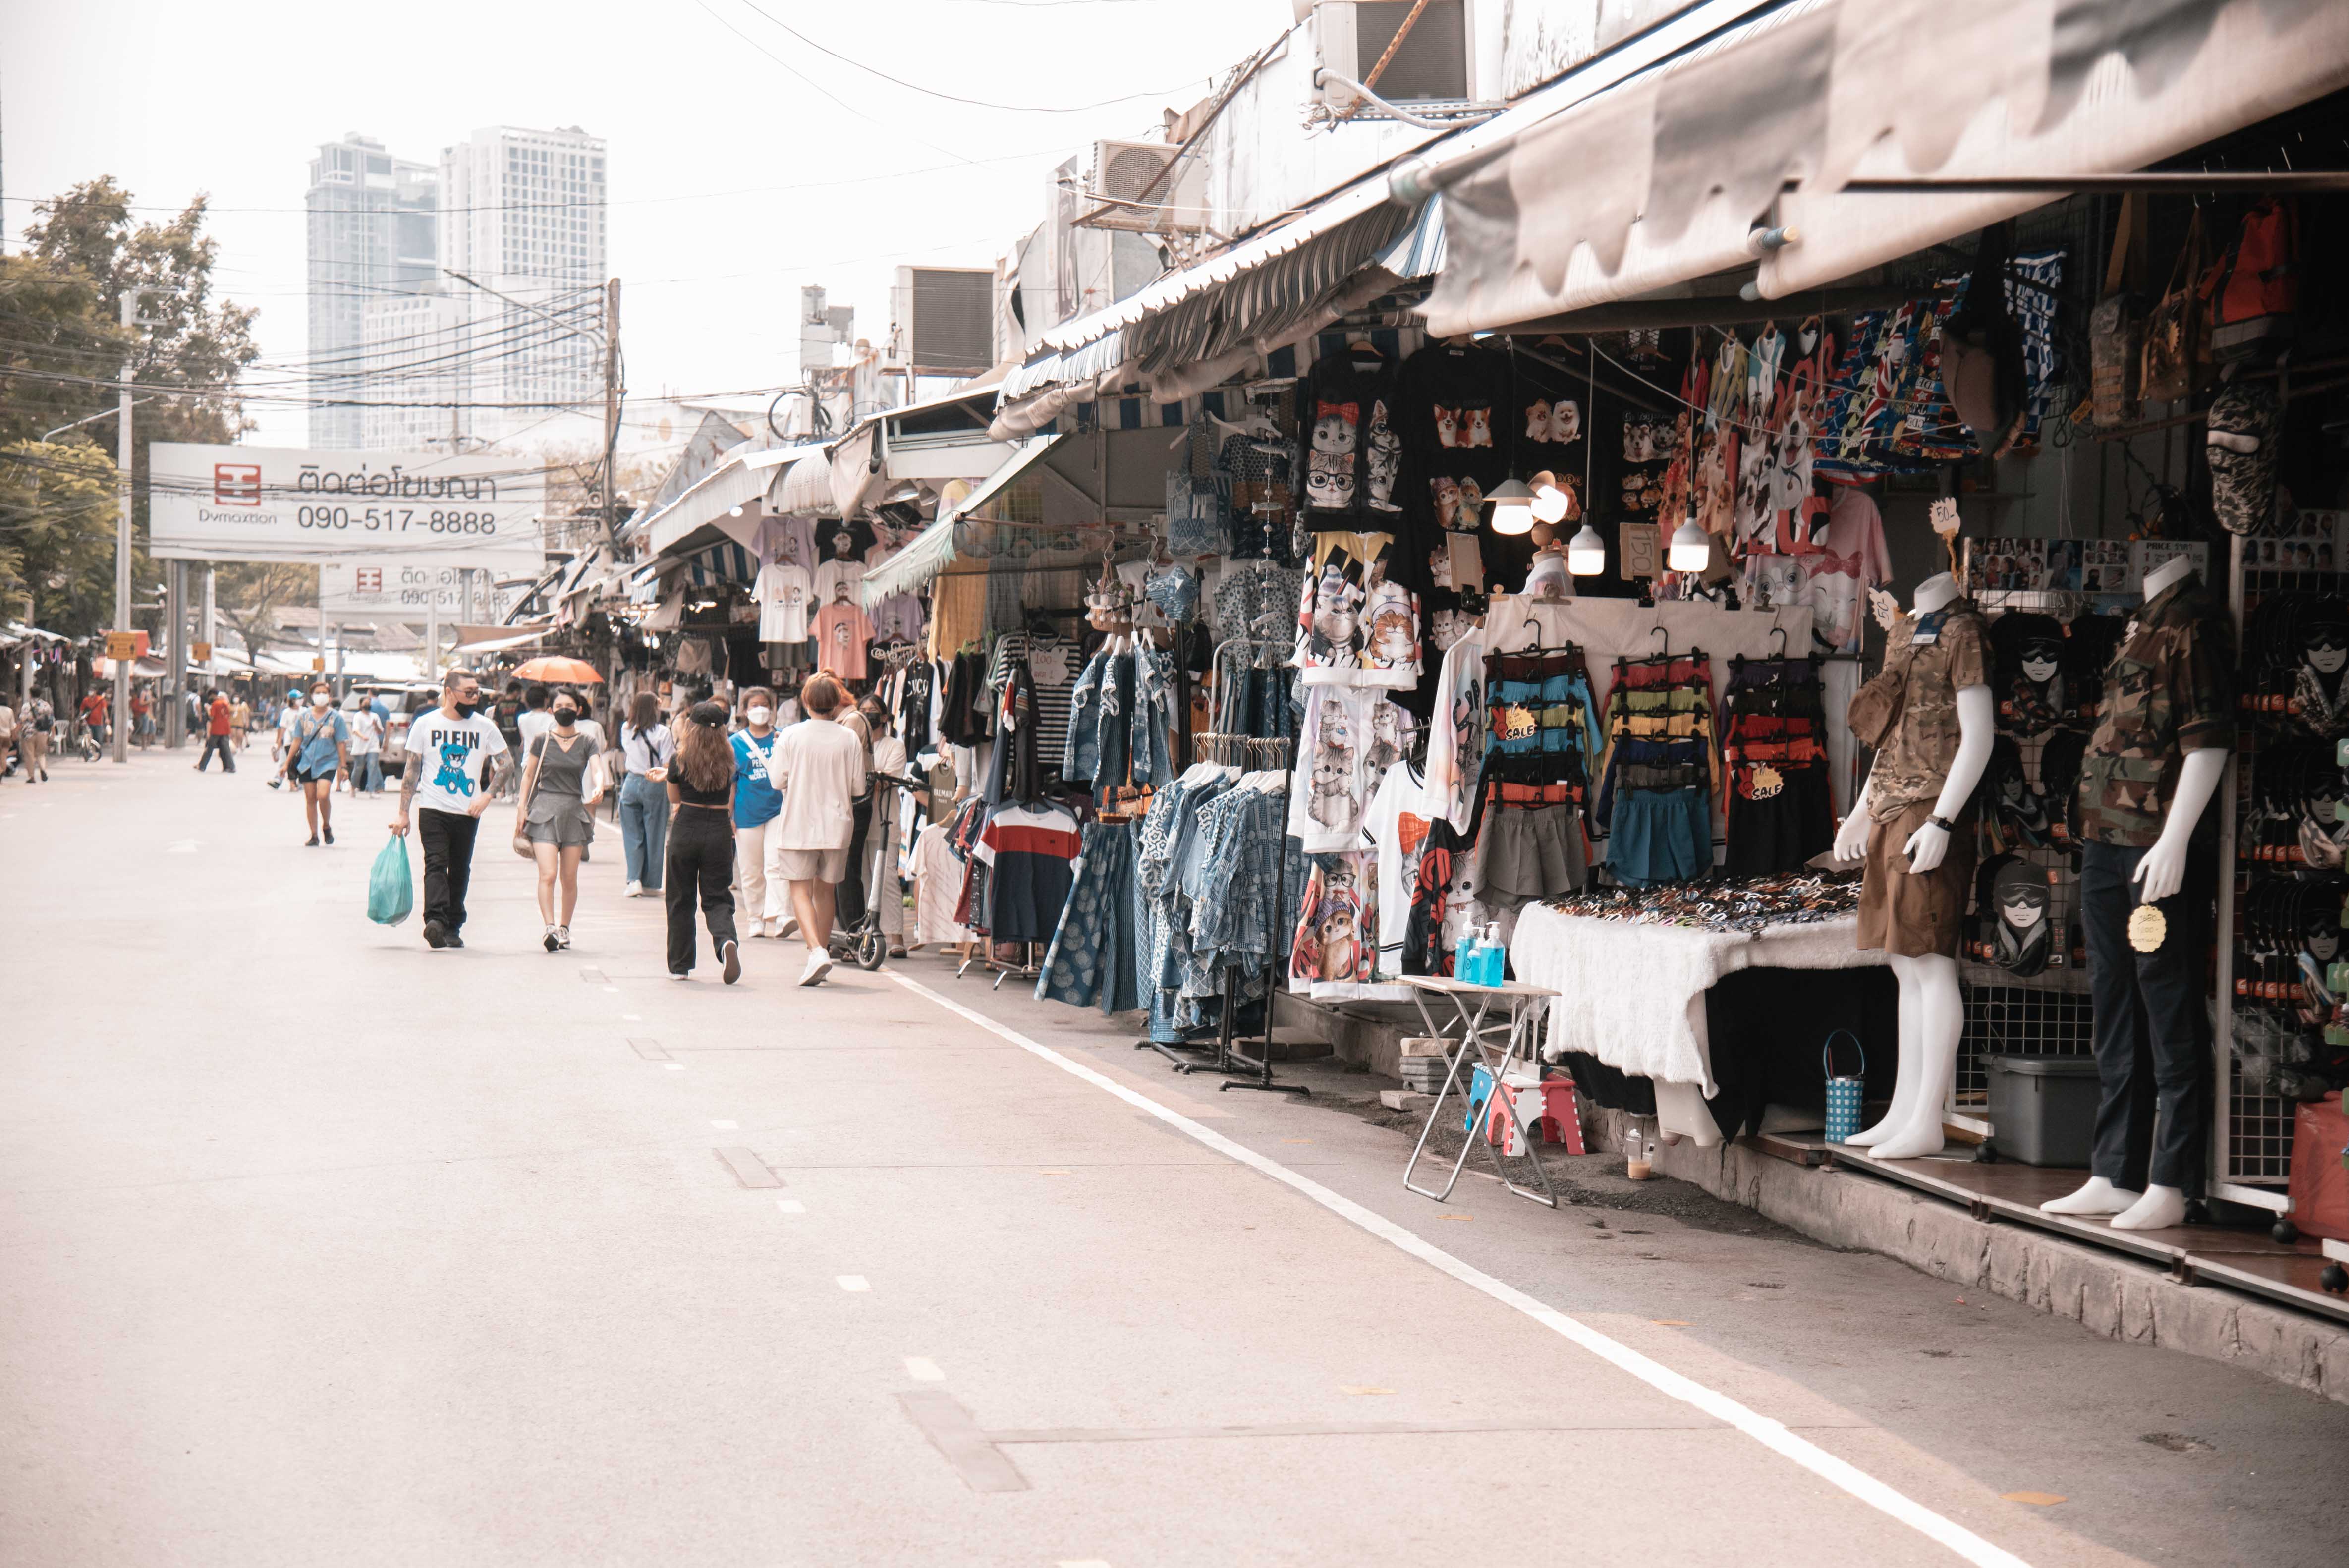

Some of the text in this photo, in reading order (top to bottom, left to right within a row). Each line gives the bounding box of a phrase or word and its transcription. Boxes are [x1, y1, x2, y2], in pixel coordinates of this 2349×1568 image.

[298, 506, 496, 535] 090-517-8888
[1505, 724, 1534, 740] SALE
[1751, 784, 1783, 800] SALE
